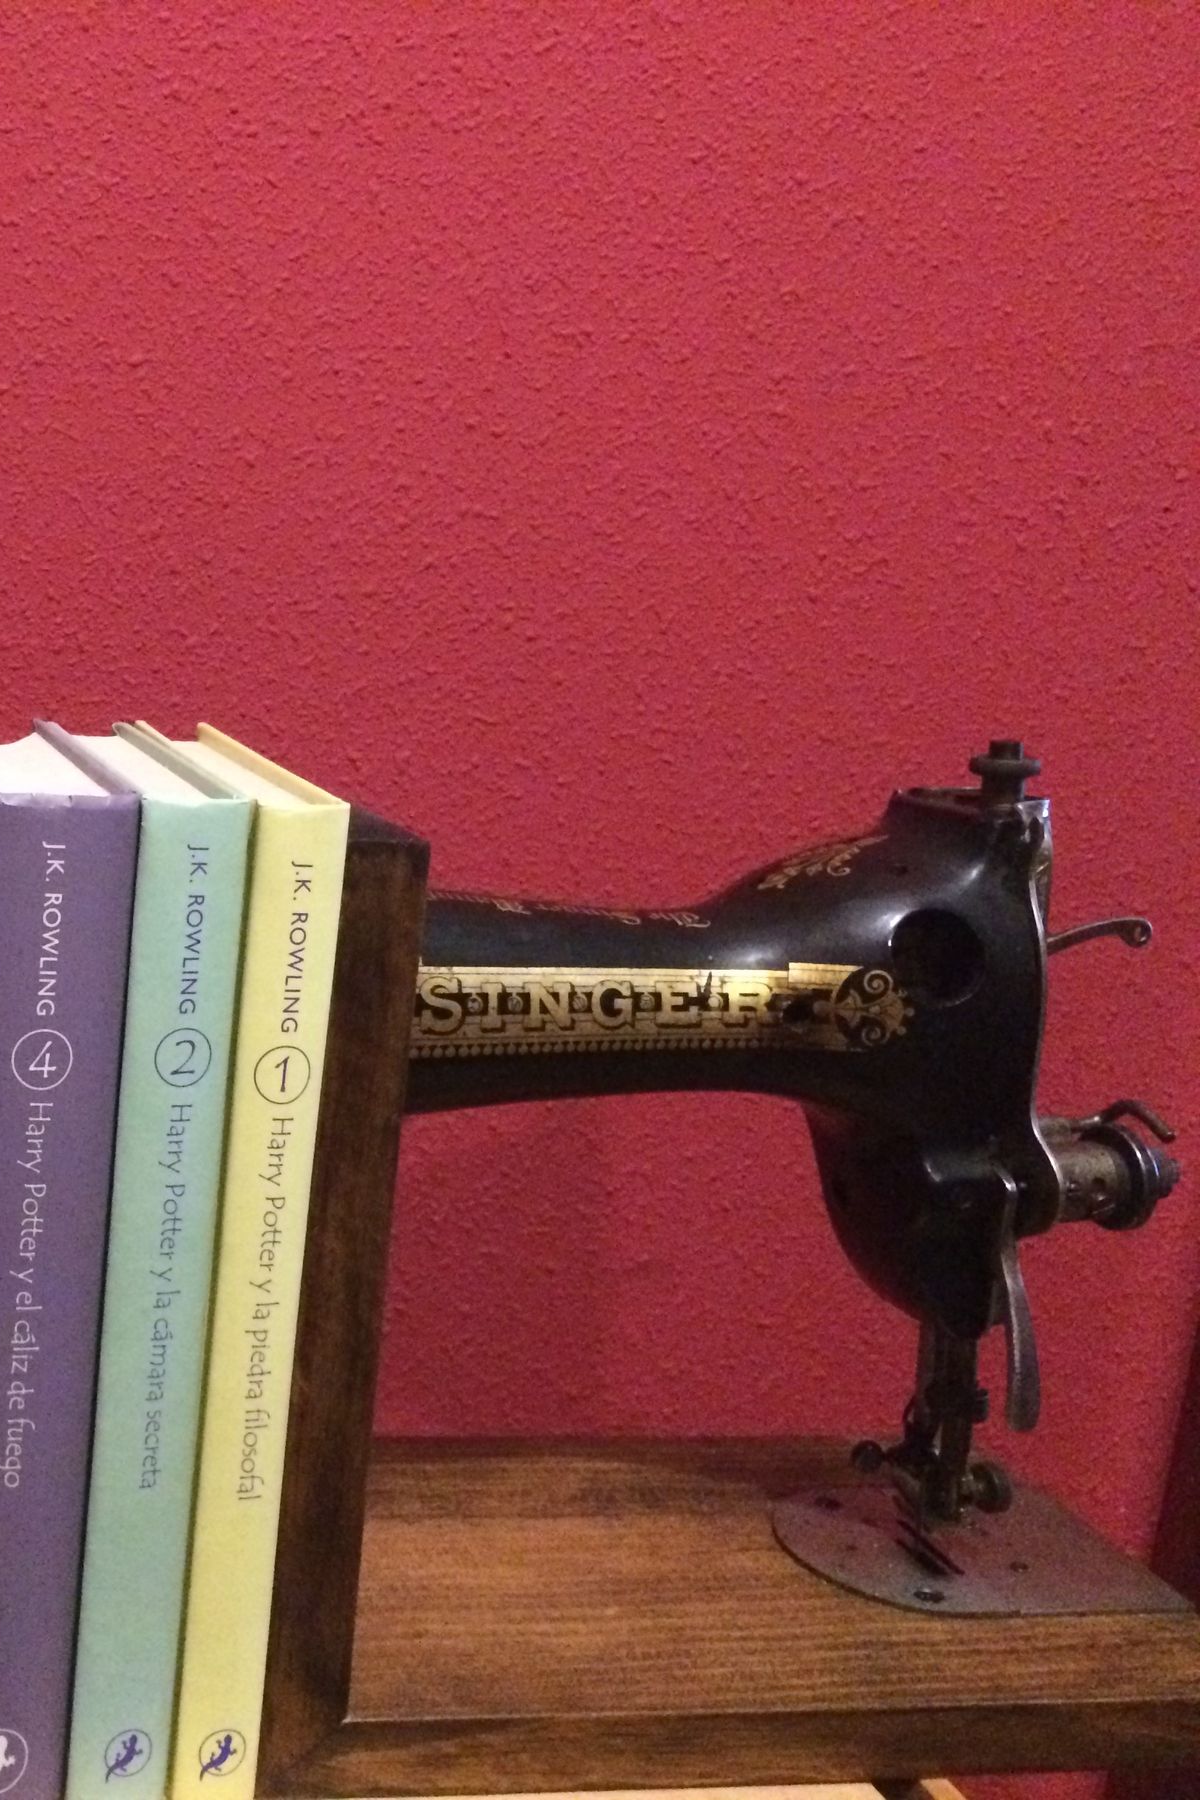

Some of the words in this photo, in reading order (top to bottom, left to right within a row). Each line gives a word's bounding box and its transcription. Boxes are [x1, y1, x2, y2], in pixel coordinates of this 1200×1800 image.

[41, 840, 66, 883] J.K.
[186, 843, 210, 884] J.K.
[290, 860, 314, 901] J.K.
[35, 891, 64, 1017] ROWLING
[177, 893, 206, 1015] ROWLING
[279, 911, 310, 1034] ROWLING
[418, 976, 779, 1034] SINGER
[28, 1040, 58, 1079] 4
[169, 1039, 197, 1076] 2
[274, 1055, 290, 1093] 1
[16, 1101, 54, 1173] Harry
[158, 1102, 193, 1174] Harry
[257, 1116, 294, 1187] Harry
[18, 1183, 47, 1260] Potter
[158, 1183, 186, 1260] Potter
[258, 1195, 286, 1274] Potter
[8, 1268, 37, 1284] y
[14, 1290, 42, 1310] el
[149, 1266, 174, 1284] y
[152, 1289, 181, 1308] la
[248, 1279, 272, 1294] y
[251, 1301, 280, 1320] la
[9, 1319, 40, 1374] cáliz
[143, 1316, 174, 1401] cámara
[243, 1328, 277, 1401] piedra
[6, 1380, 35, 1410] de
[138, 1408, 162, 1490] secreta
[237, 1408, 271, 1501] filosofal
